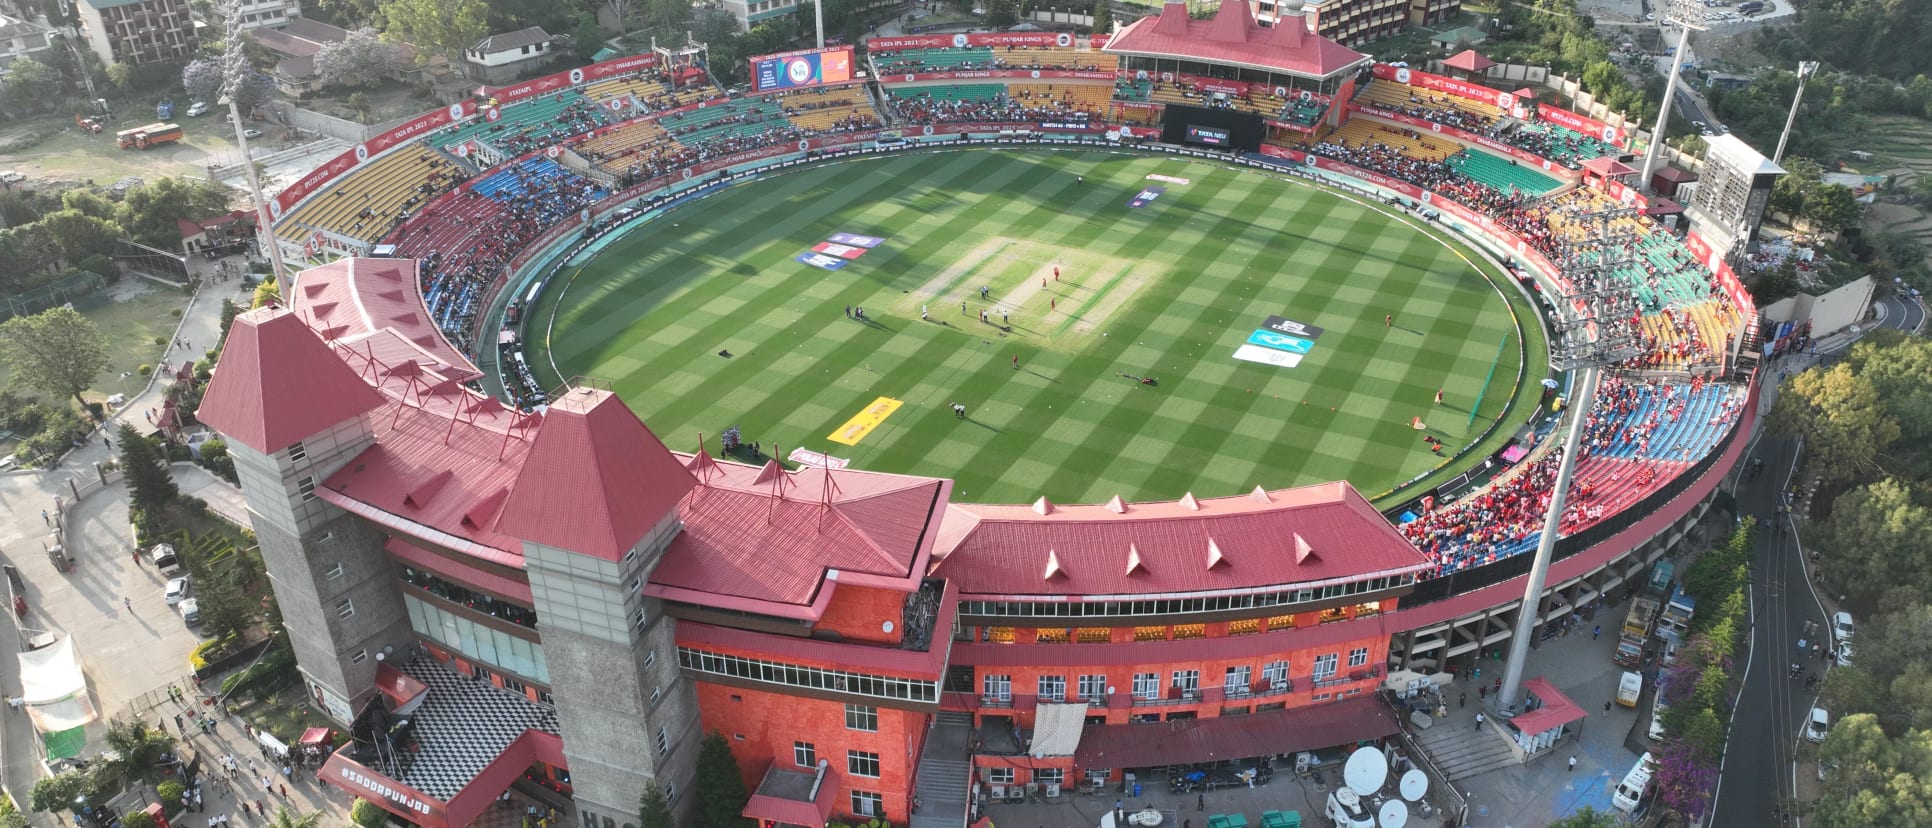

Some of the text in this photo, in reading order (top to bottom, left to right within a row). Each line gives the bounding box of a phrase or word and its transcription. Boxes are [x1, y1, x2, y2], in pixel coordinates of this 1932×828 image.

[616, 56, 656, 69] DHARAMSHALA
[1445, 82, 1483, 97] TATA IPL 2023
[1360, 106, 1394, 119] PUNJAB KINGS
[395, 120, 428, 139] TATA IPL 2023
[1197, 130, 1213, 138] TATA
[1354, 169, 1386, 184] IPLT20.COM
[341, 767, 431, 815] #SADDAPUNJAB
